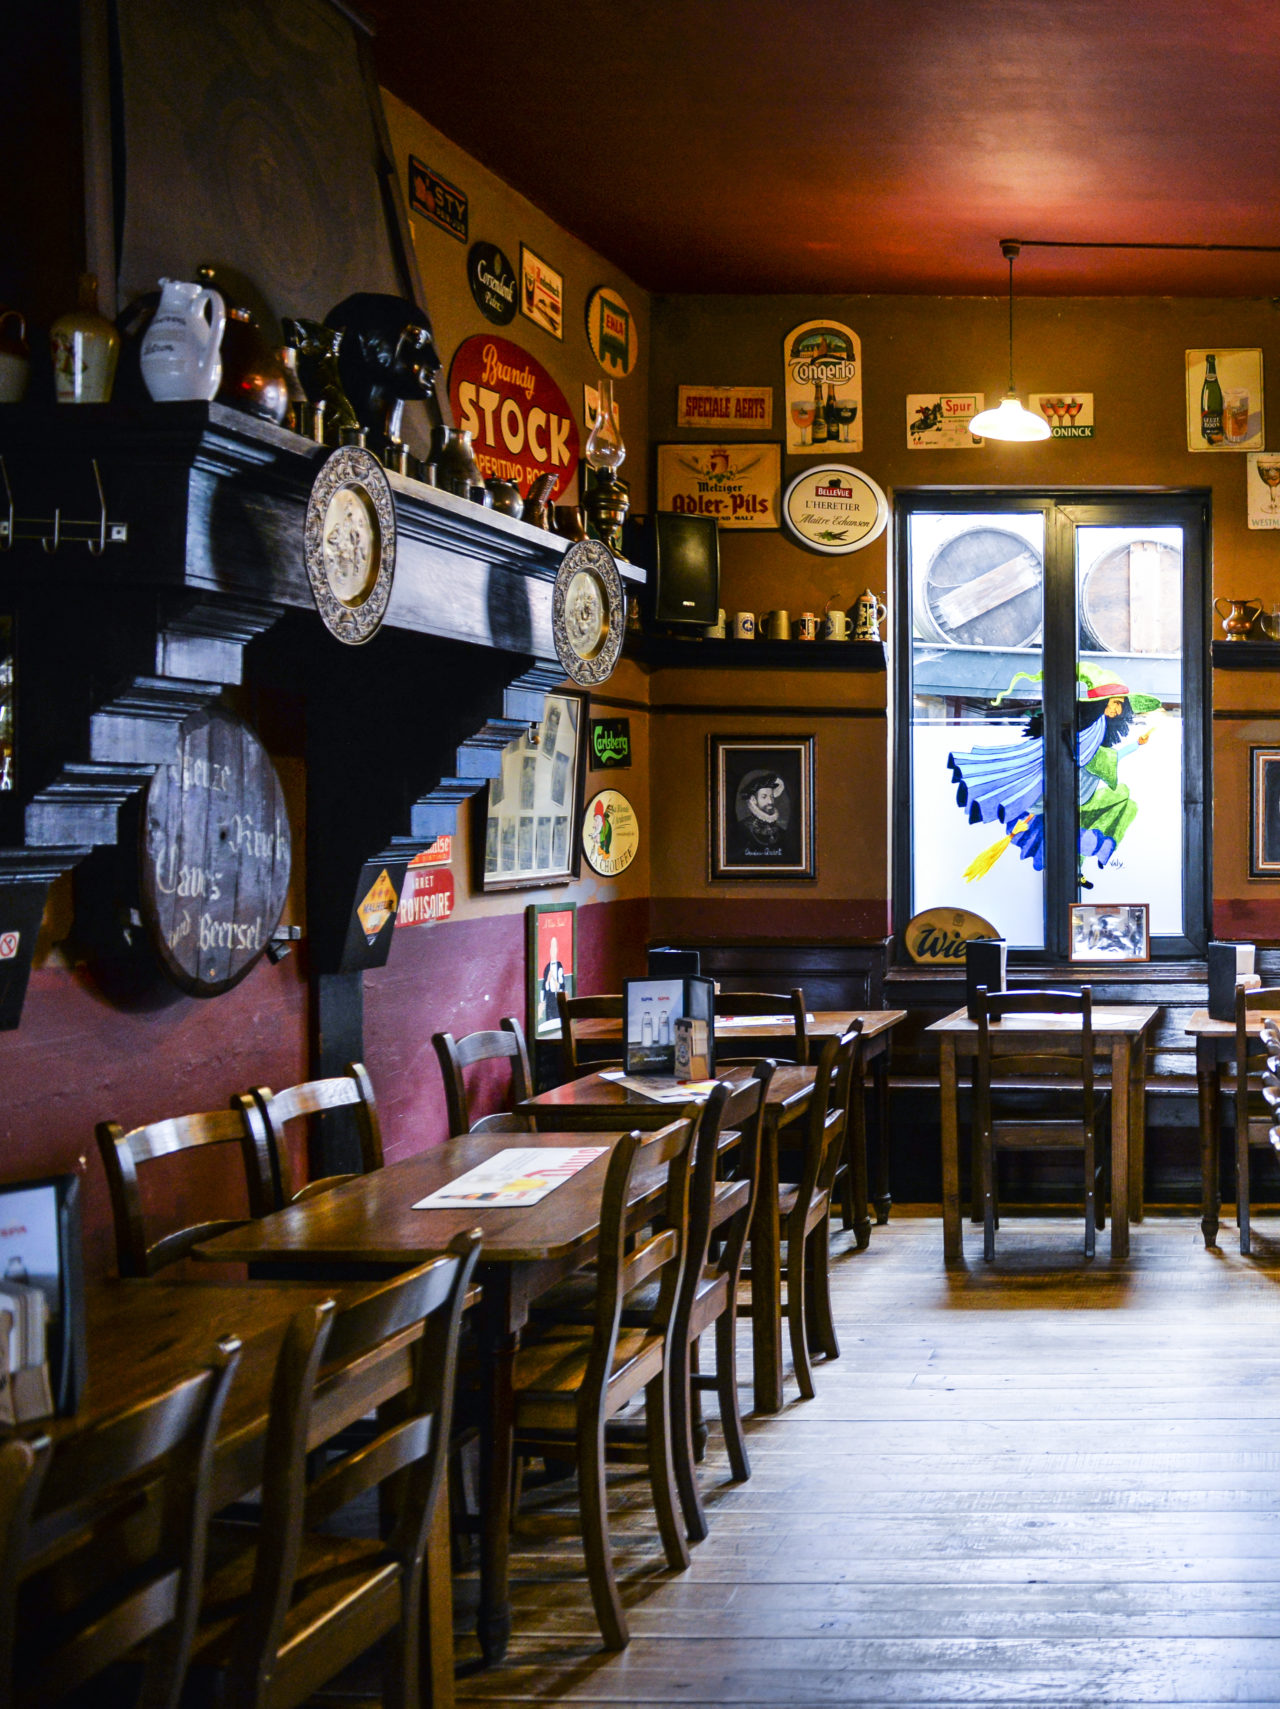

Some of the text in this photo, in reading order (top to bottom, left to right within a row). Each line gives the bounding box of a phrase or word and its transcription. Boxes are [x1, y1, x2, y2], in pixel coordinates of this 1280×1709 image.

[482, 344, 535, 399] Brandy
[788, 358, 855, 385] Tongerlo
[685, 396, 766, 419] SPECIALE AERTS
[945, 399, 972, 415] Spur
[458, 381, 571, 468] STOCK
[672, 494, 769, 515] Adler-Pils
[805, 500, 861, 512] L'HERETIER
[594, 725, 628, 763] Carlsberg
